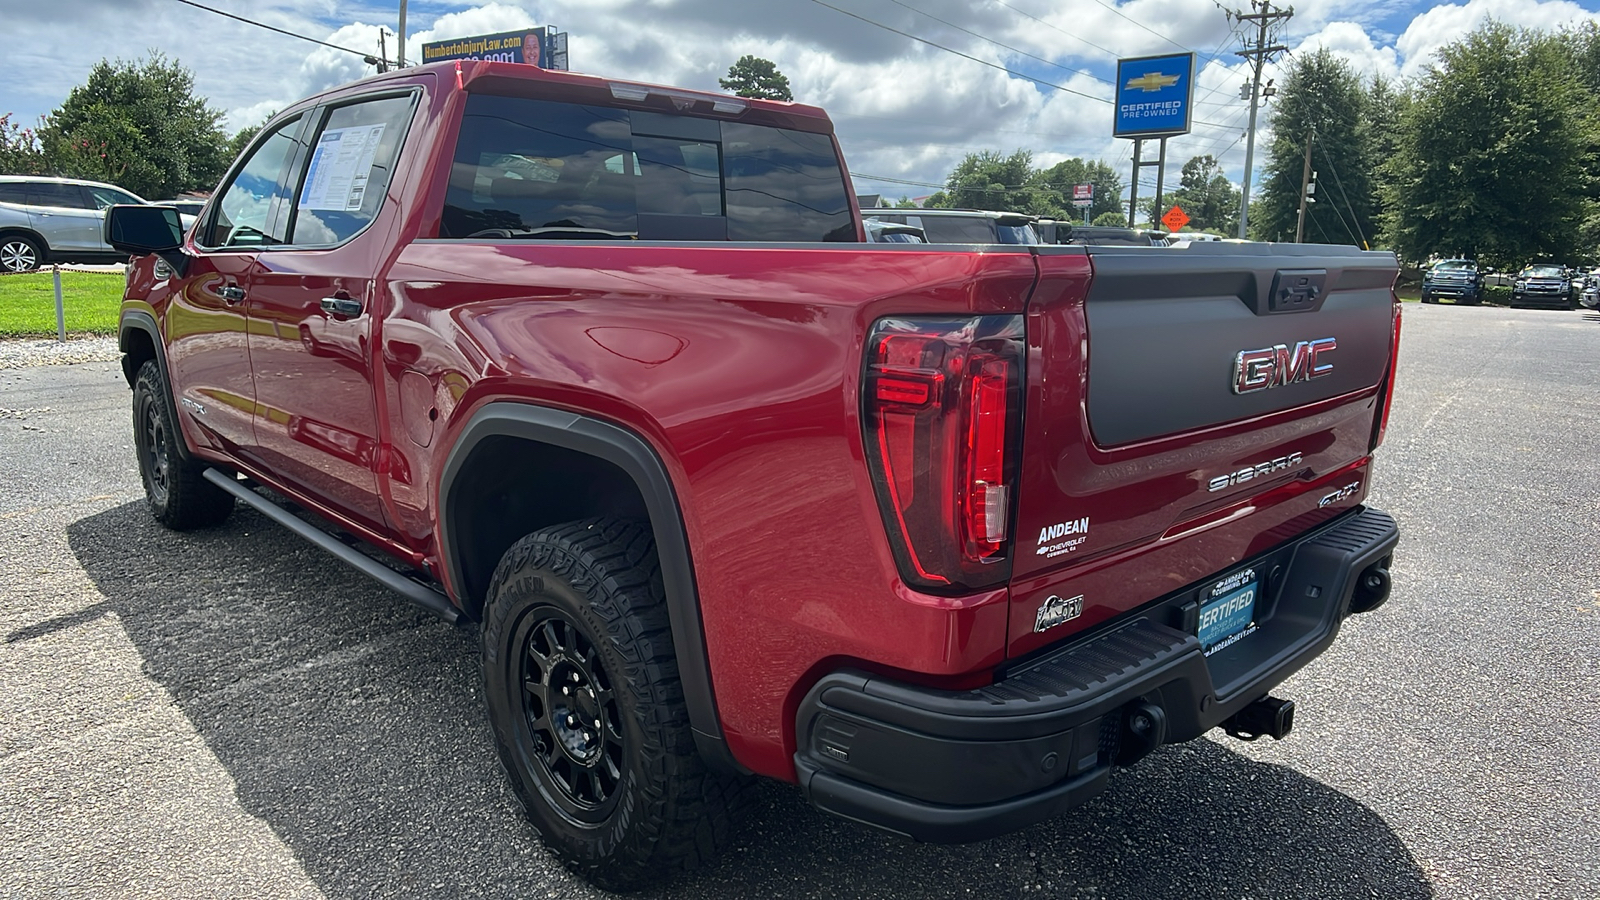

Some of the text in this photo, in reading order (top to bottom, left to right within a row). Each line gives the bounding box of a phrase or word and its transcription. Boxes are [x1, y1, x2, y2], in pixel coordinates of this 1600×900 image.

[425, 36, 521, 59] HumbertoInjuryLaw.com
[1121, 101, 1181, 112] CERTIFIED
[1123, 108, 1178, 119] PRE-OWNED
[1232, 337, 1337, 395] GMC
[1207, 451, 1303, 493] SIERRA
[1037, 517, 1090, 545] ANDEAN
[1049, 536, 1087, 552] CHEVROLET
